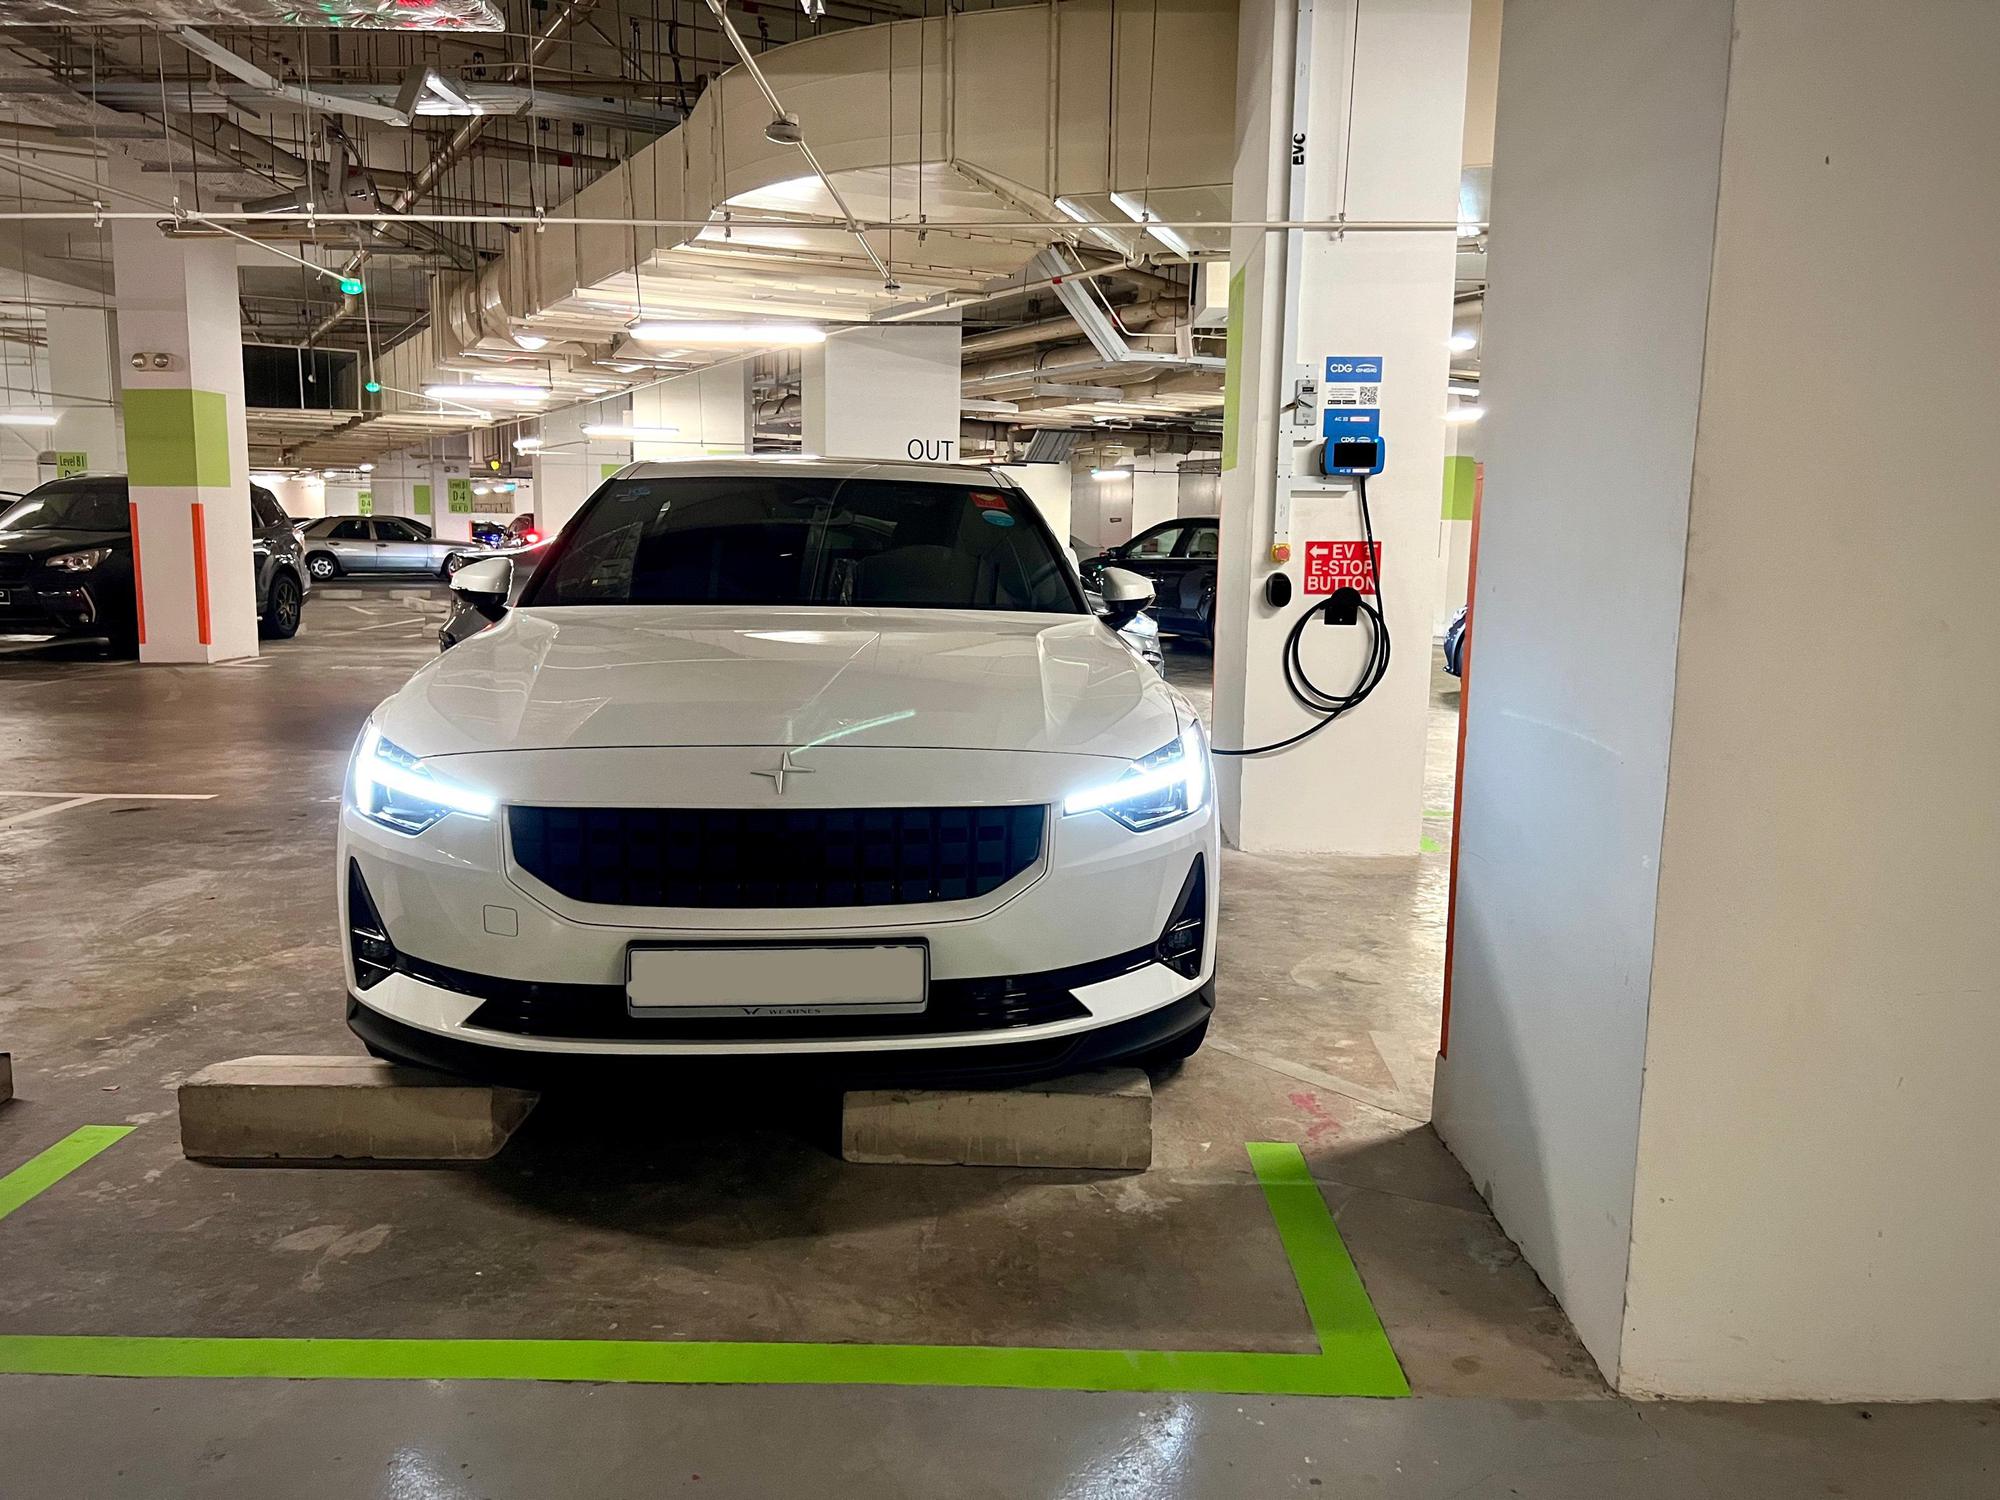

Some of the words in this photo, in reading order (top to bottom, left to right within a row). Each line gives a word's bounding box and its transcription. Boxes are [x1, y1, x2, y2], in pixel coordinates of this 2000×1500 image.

[1293, 133, 1306, 165] EVC
[1330, 364, 1353, 373] CDG
[908, 439, 954, 461] OUT
[60, 456, 75, 466] Level
[1333, 544, 1355, 559] EV
[1312, 560, 1373, 575] E-STOP
[1307, 575, 1376, 591] BUTTON
